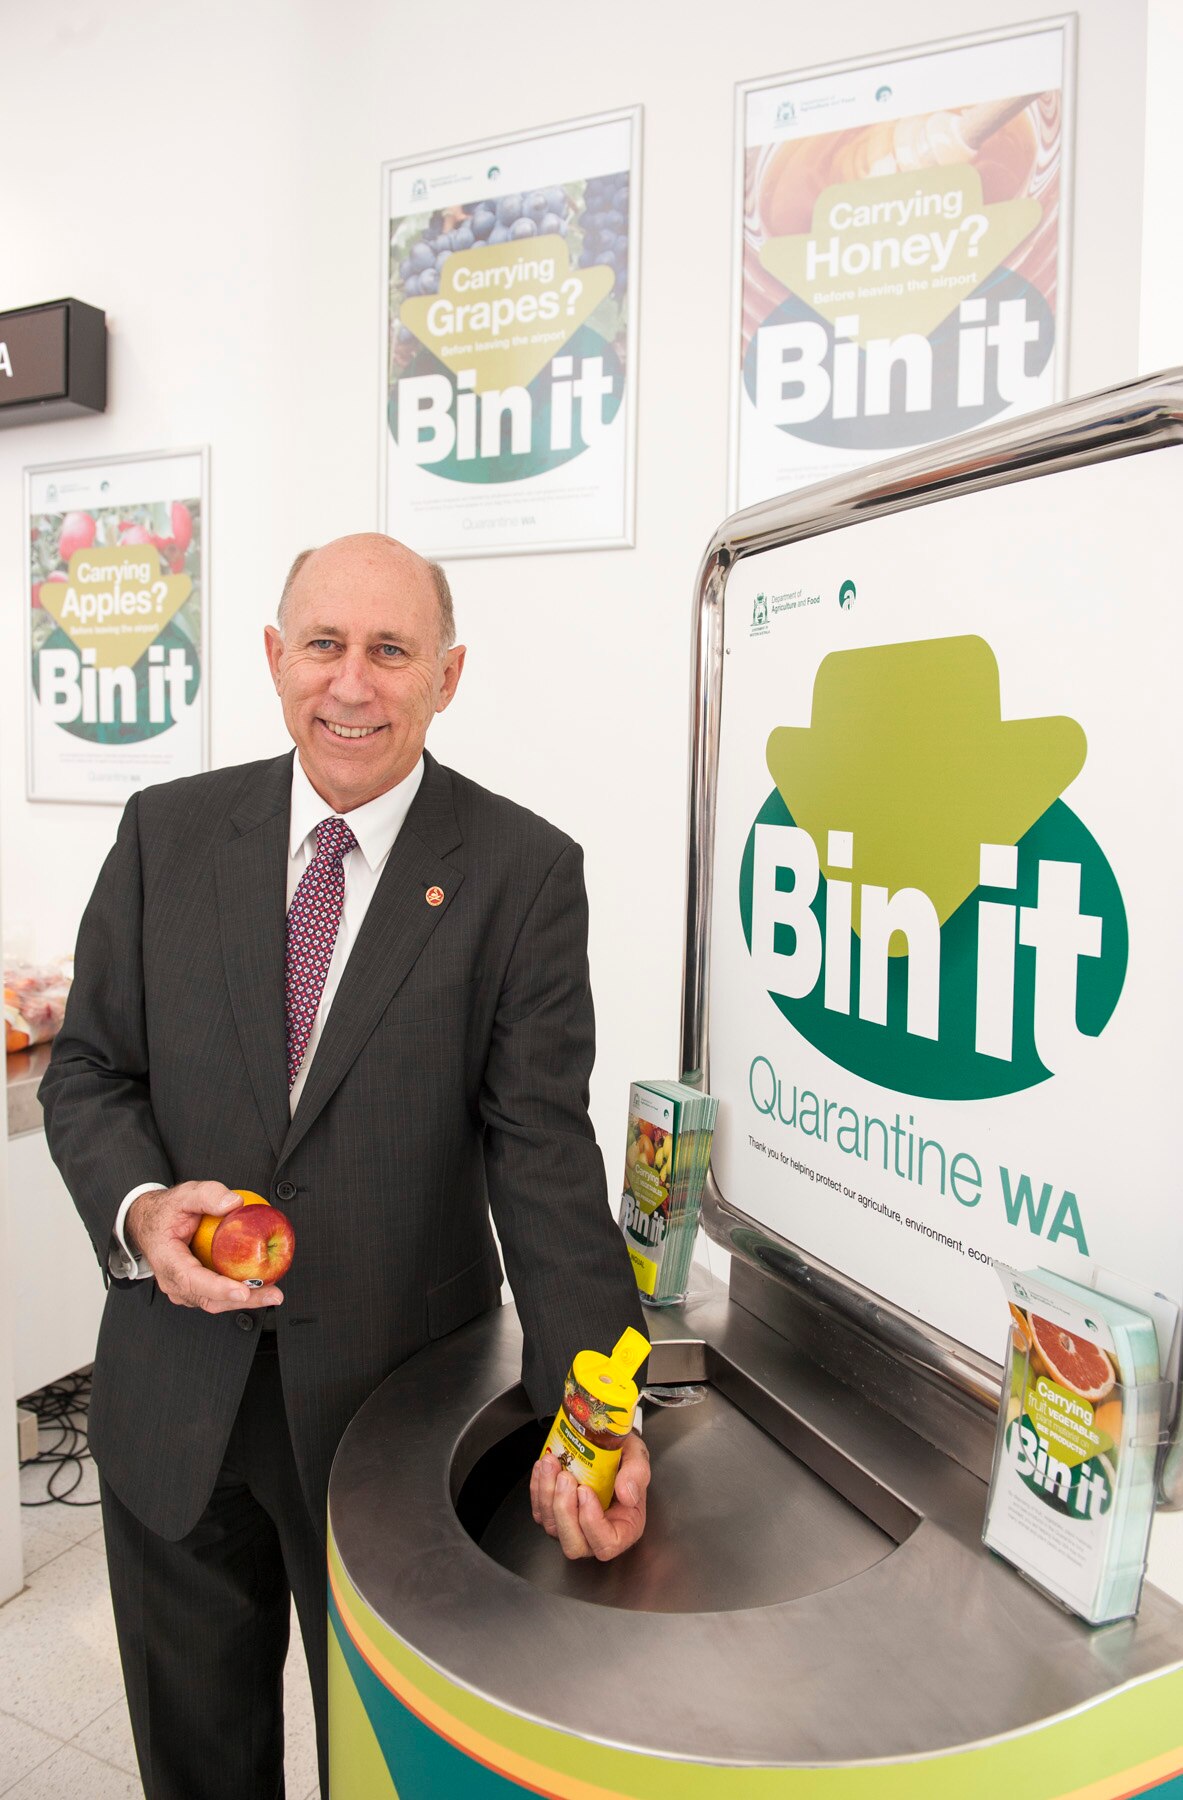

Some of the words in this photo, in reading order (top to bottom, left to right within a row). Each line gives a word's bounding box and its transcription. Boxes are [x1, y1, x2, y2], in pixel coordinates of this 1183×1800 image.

[829, 190, 963, 231] Carrying
[452, 257, 555, 292] Carrying
[806, 214, 989, 281] Honey?
[426, 278, 584, 338] Grapes?
[813, 288, 856, 305] Before
[857, 280, 904, 298] leaving
[907, 274, 928, 291] the
[931, 271, 978, 289] airport
[756, 314, 934, 427] Bin
[957, 298, 1040, 408] it
[398, 368, 532, 466] Bin
[550, 355, 613, 452] it
[60, 581, 169, 624] Apples?
[77, 560, 151, 585] Carrying
[39, 647, 137, 725] Bin
[148, 645, 194, 725] it
[751, 823, 941, 1042] Bin
[975, 843, 1103, 1080] it
[749, 1055, 983, 1208] Quarantine
[999, 1165, 1090, 1257] WA
[748, 1135, 767, 1154] Thank
[767, 1147, 779, 1160] you
[780, 1152, 789, 1165] for
[790, 1158, 815, 1181] helping
[816, 1172, 842, 1193] protect
[843, 1186, 856, 1200] our
[857, 1193, 903, 1226] agriculture,
[905, 1216, 965, 1256] environment,
[1028, 1391, 1048, 1416] fruit
[1048, 1407, 1100, 1445] VEGETABLES
[1038, 1381, 1093, 1428] Carrying
[564, 1428, 586, 1453] Organic
[1008, 1422, 1072, 1503] Bin
[1075, 1463, 1109, 1519] it
